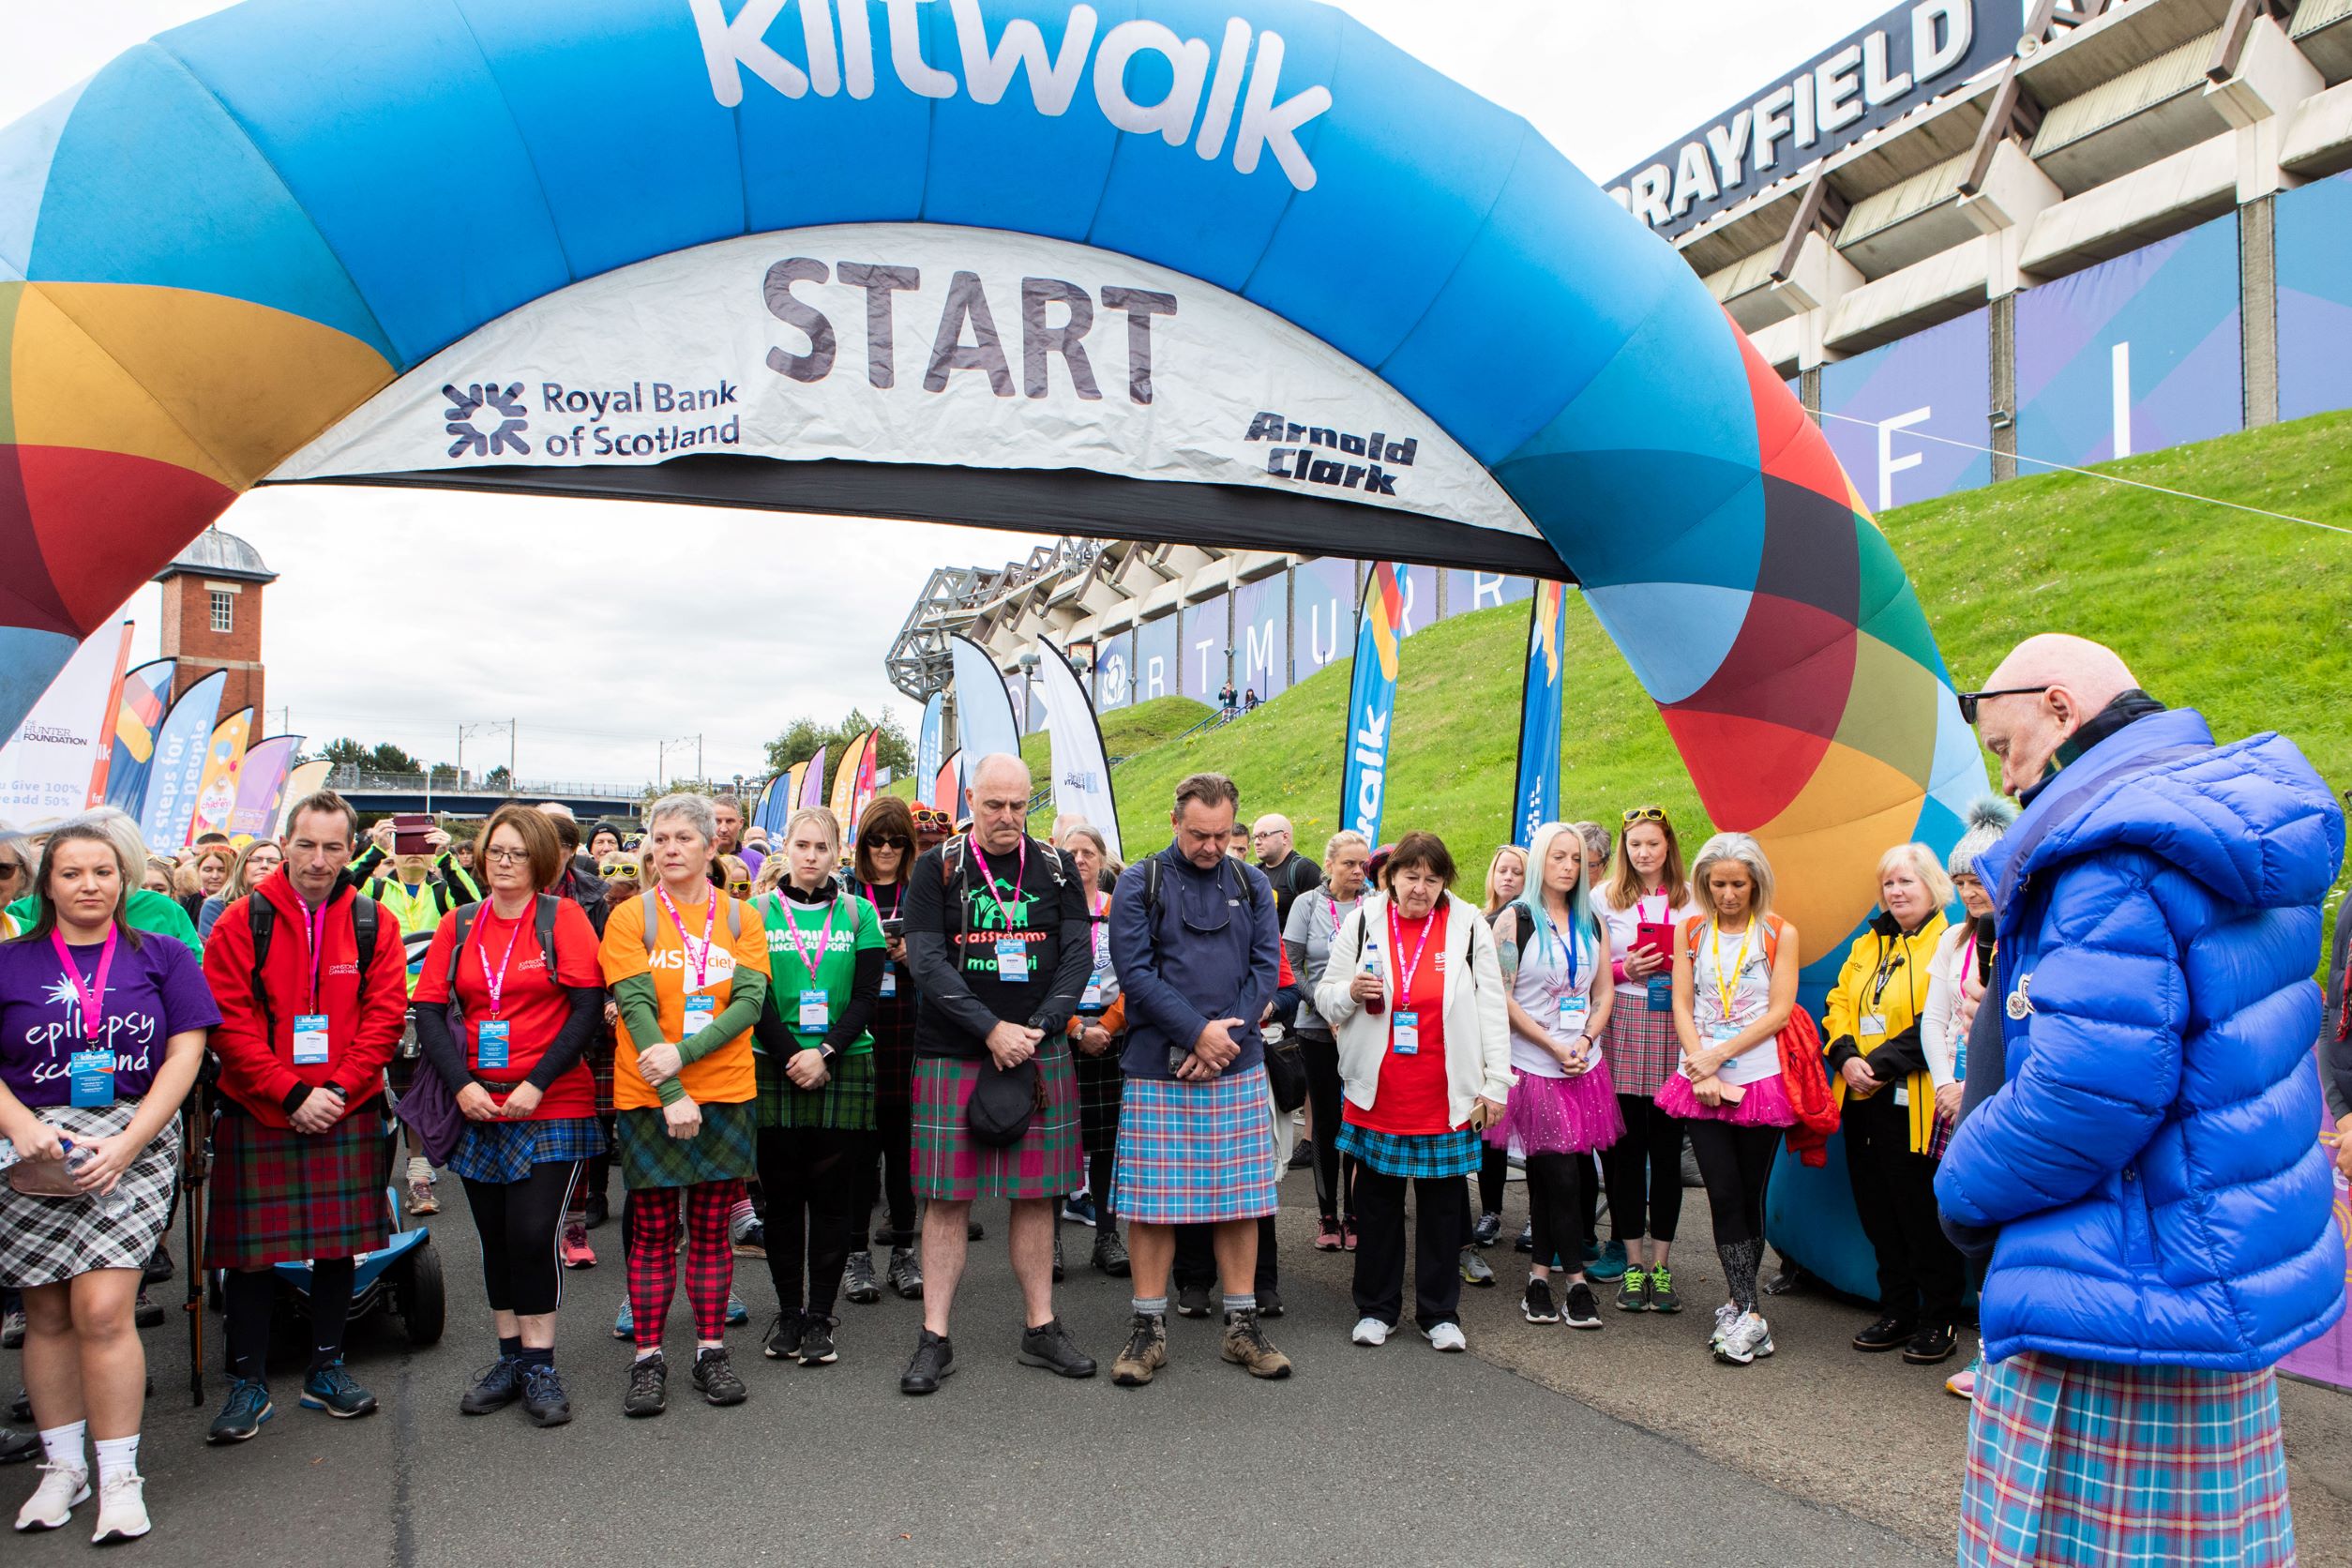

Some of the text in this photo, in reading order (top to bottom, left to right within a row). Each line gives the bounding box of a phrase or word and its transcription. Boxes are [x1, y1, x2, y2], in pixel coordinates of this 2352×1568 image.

[690, 0, 1333, 191] kiltwalk
[762, 257, 1178, 405] START
[542, 380, 738, 422] Royal Bank
[546, 415, 739, 457] of Scotland
[1244, 411, 1419, 466] Arnold
[1268, 447, 1398, 496] Clark
[23, 733, 87, 746] FOUNDATION
[24, 725, 71, 736] HUNTER
[160, 733, 184, 765] for
[11, 780, 39, 791] Give
[13, 794, 38, 805] add
[155, 771, 178, 828] steps
[806, 941, 851, 952] SUPORT
[955, 931, 1047, 944] cassrooms
[648, 949, 732, 970] MS Sciet
